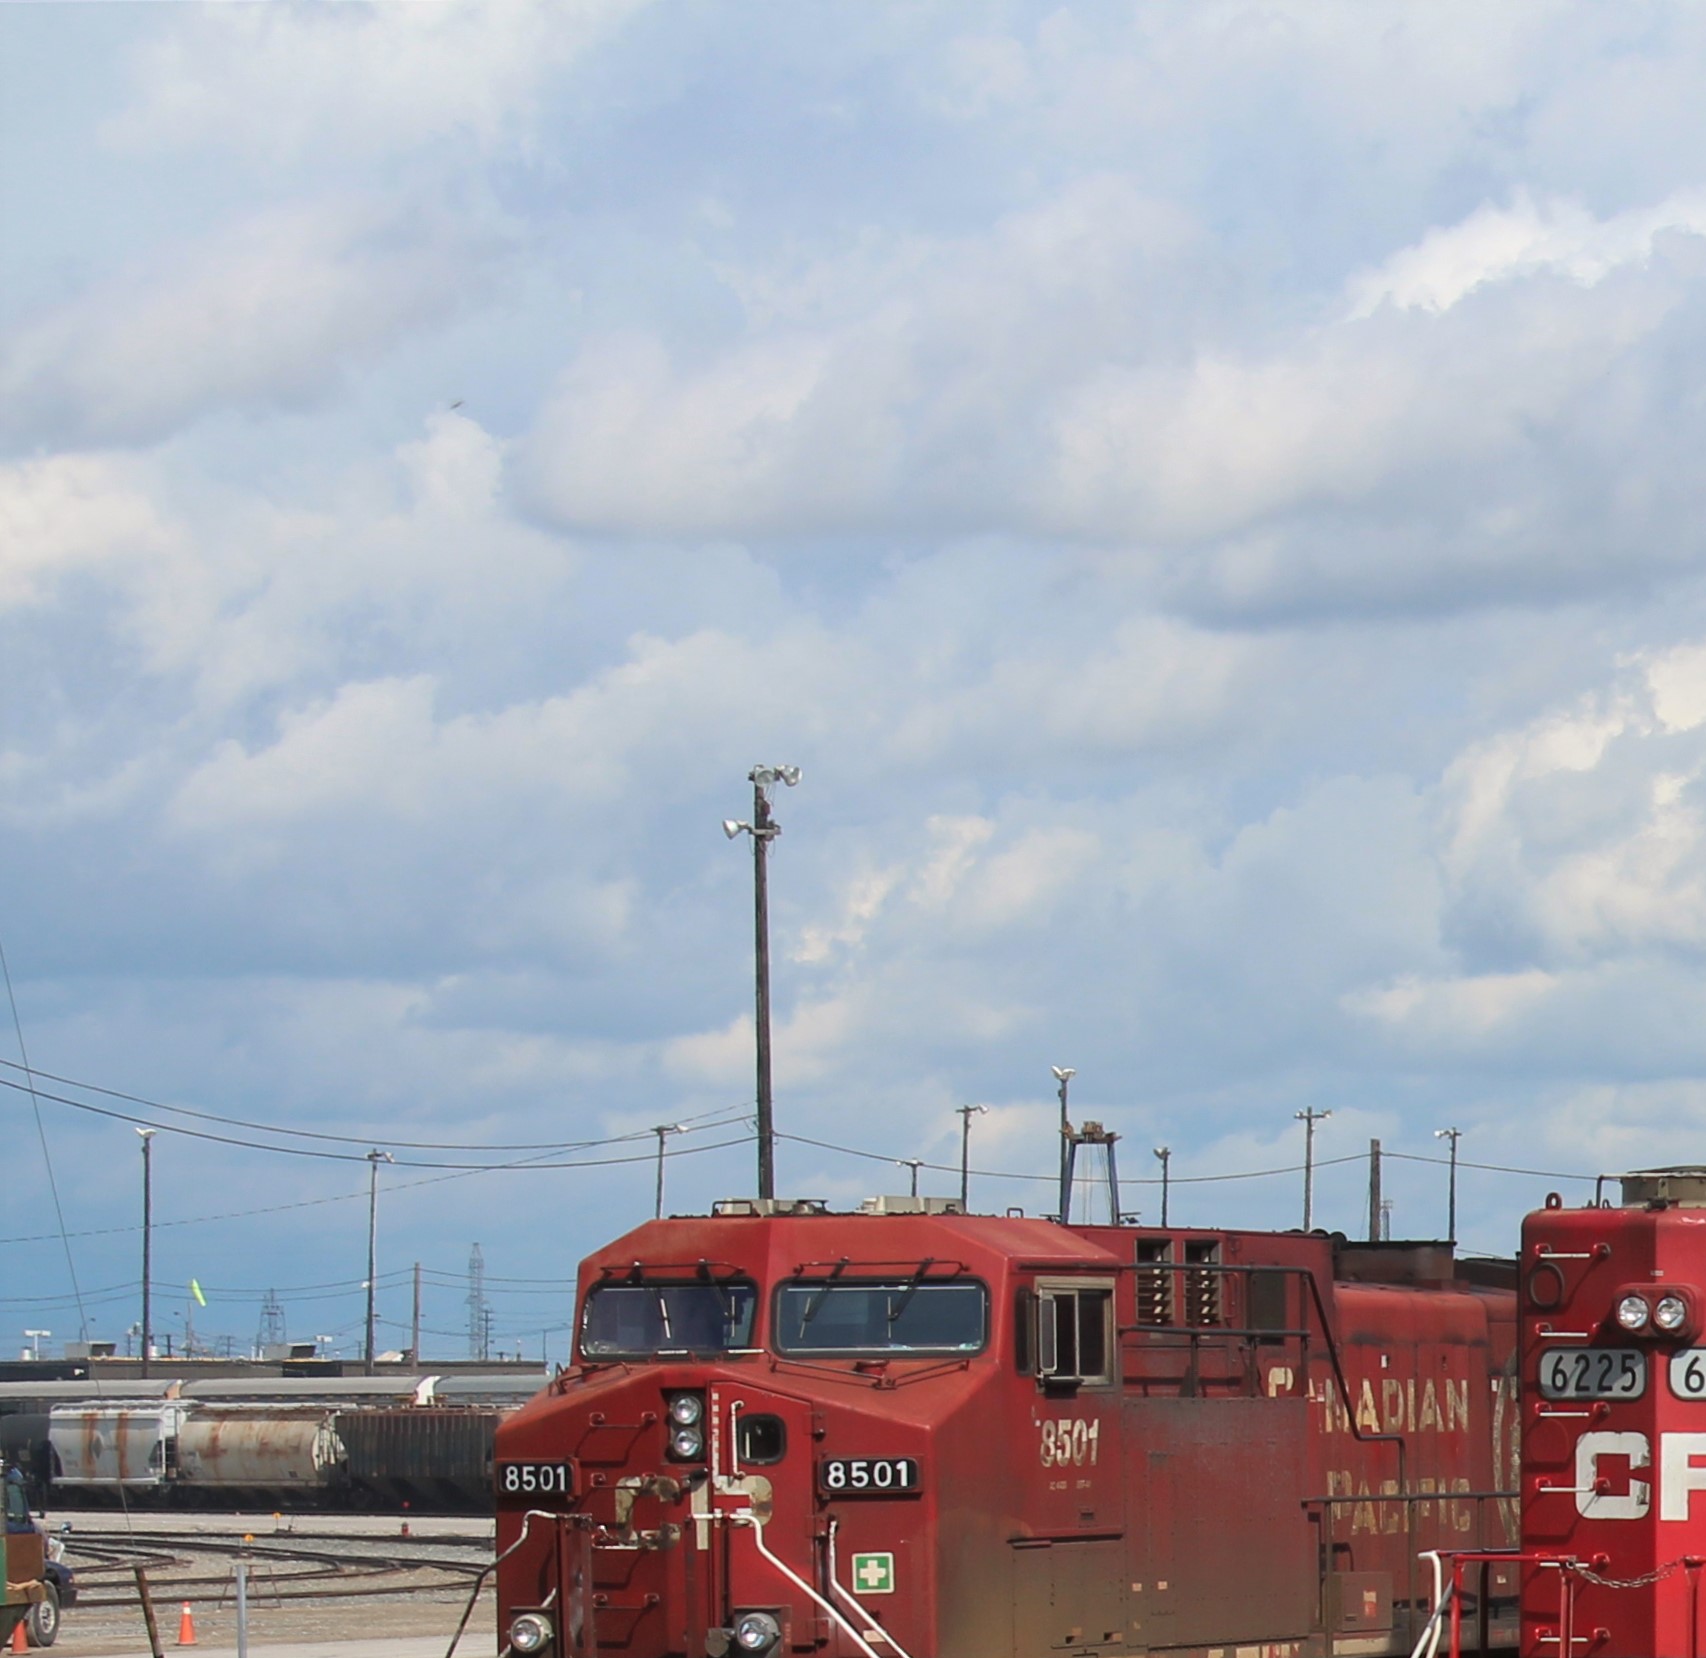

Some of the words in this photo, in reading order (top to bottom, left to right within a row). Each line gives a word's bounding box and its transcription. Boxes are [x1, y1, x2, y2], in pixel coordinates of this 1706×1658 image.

[1551, 1354, 1636, 1393] 6225
[1041, 1418, 1099, 1468] 8501
[505, 1466, 567, 1492] 8501
[827, 1461, 909, 1489] 8501
[1326, 1470, 1471, 1536] PACIFIC
